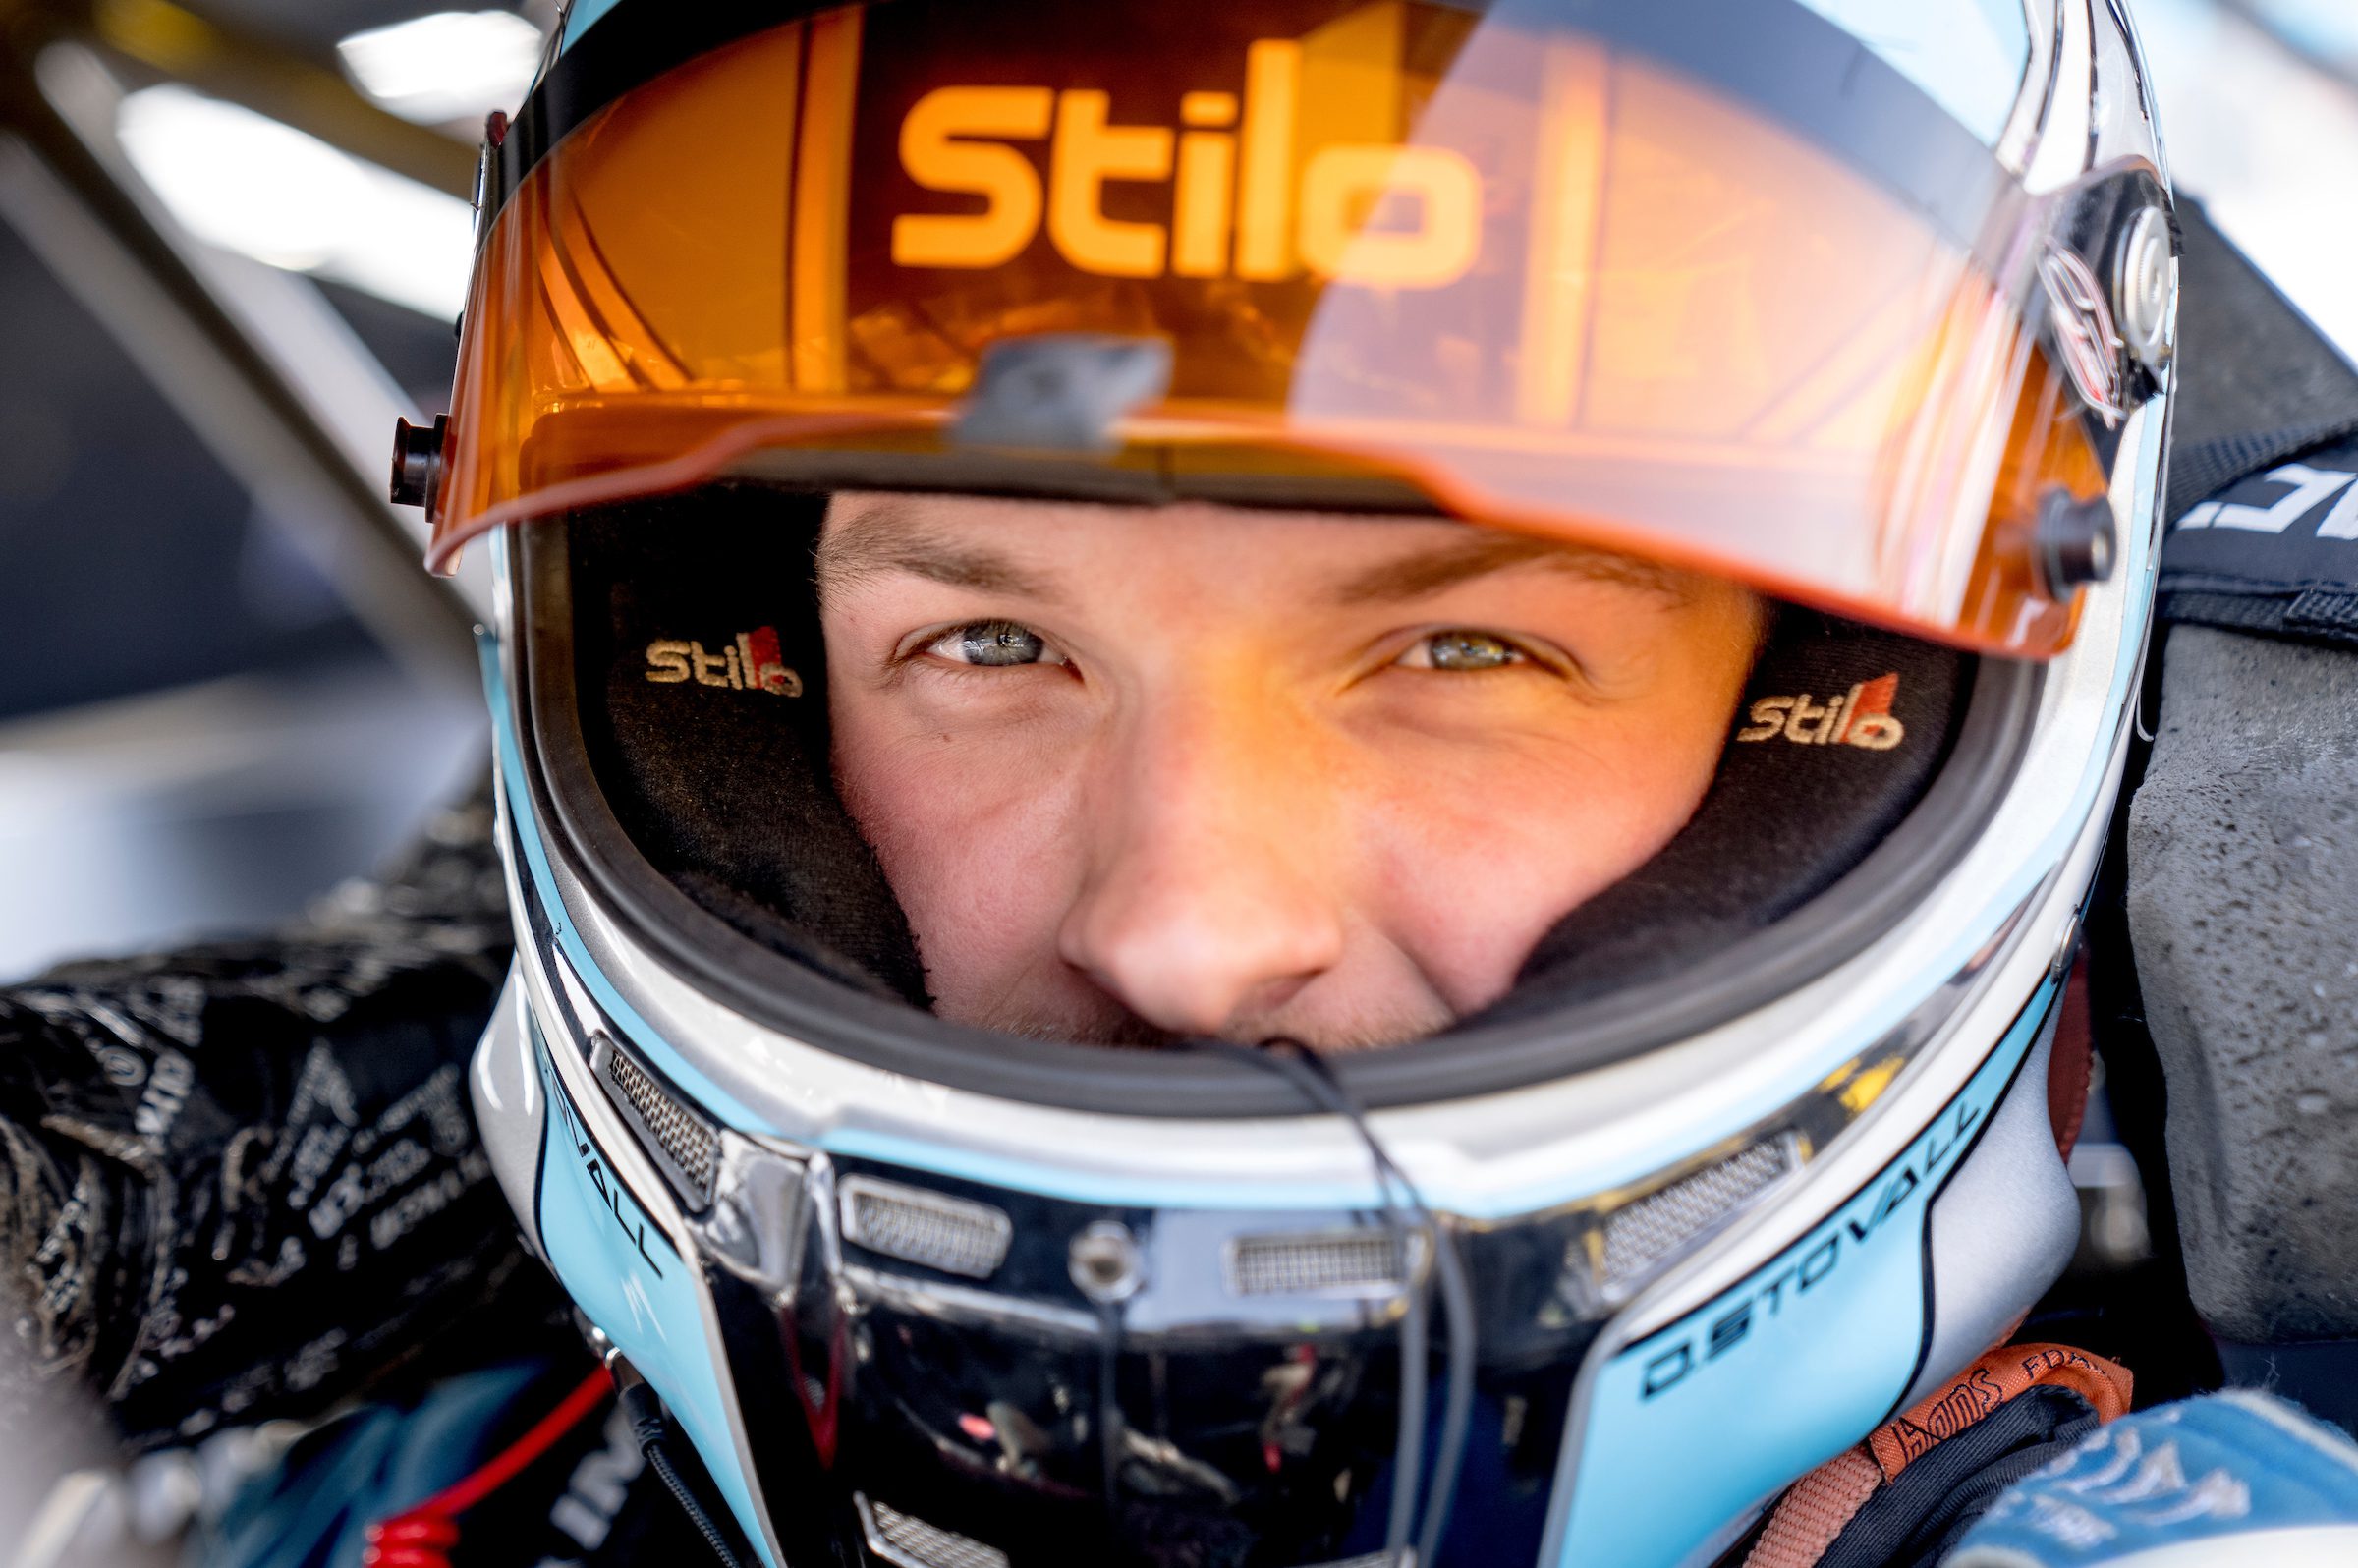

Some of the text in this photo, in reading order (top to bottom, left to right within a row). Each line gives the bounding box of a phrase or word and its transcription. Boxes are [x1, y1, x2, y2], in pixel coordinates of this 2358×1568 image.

[892, 38, 1483, 290] Stilo
[645, 632, 803, 698] Stilo
[1736, 682, 1905, 751] Stilo
